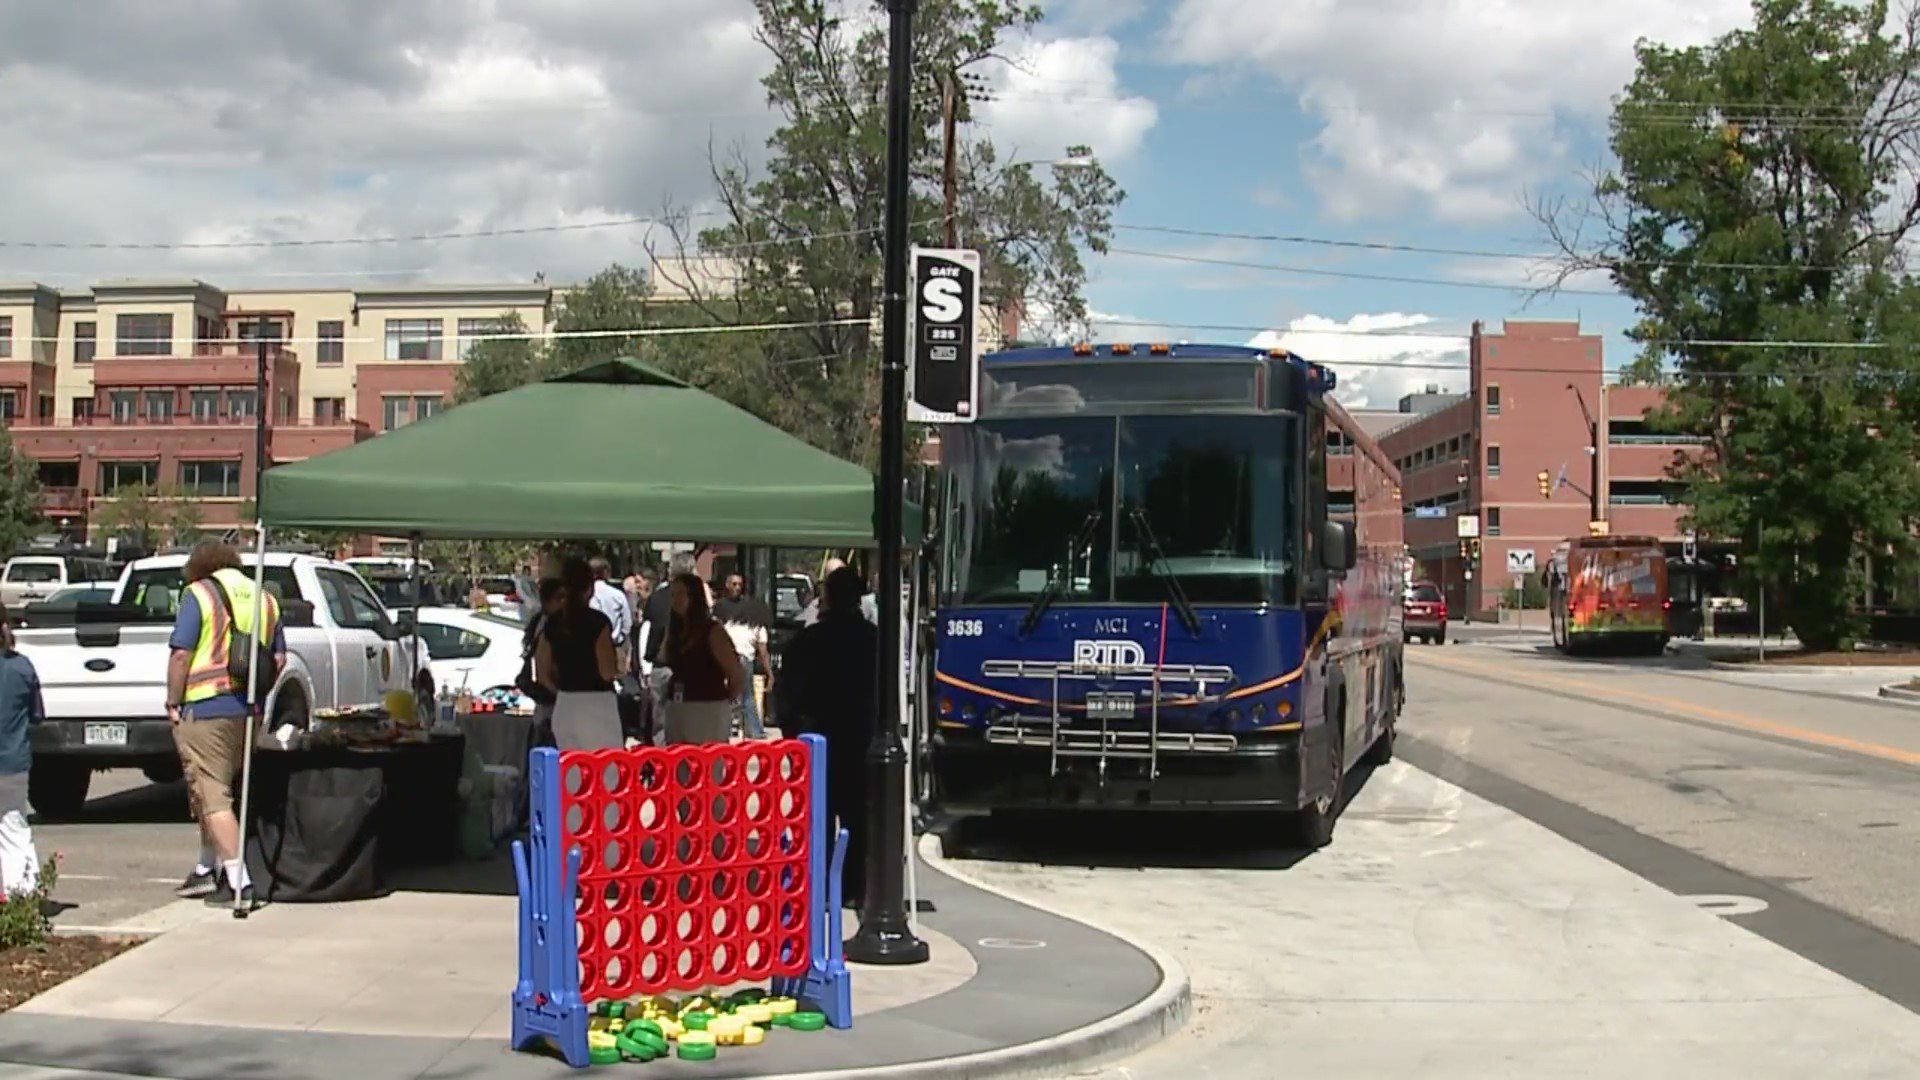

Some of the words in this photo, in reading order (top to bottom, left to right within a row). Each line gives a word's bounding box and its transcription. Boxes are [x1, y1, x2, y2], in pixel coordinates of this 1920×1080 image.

[929, 266, 961, 277] GATE
[922, 277, 963, 323] S
[947, 619, 983, 636] 3636
[1094, 618, 1129, 634] MCI
[1073, 639, 1145, 674] RTD
